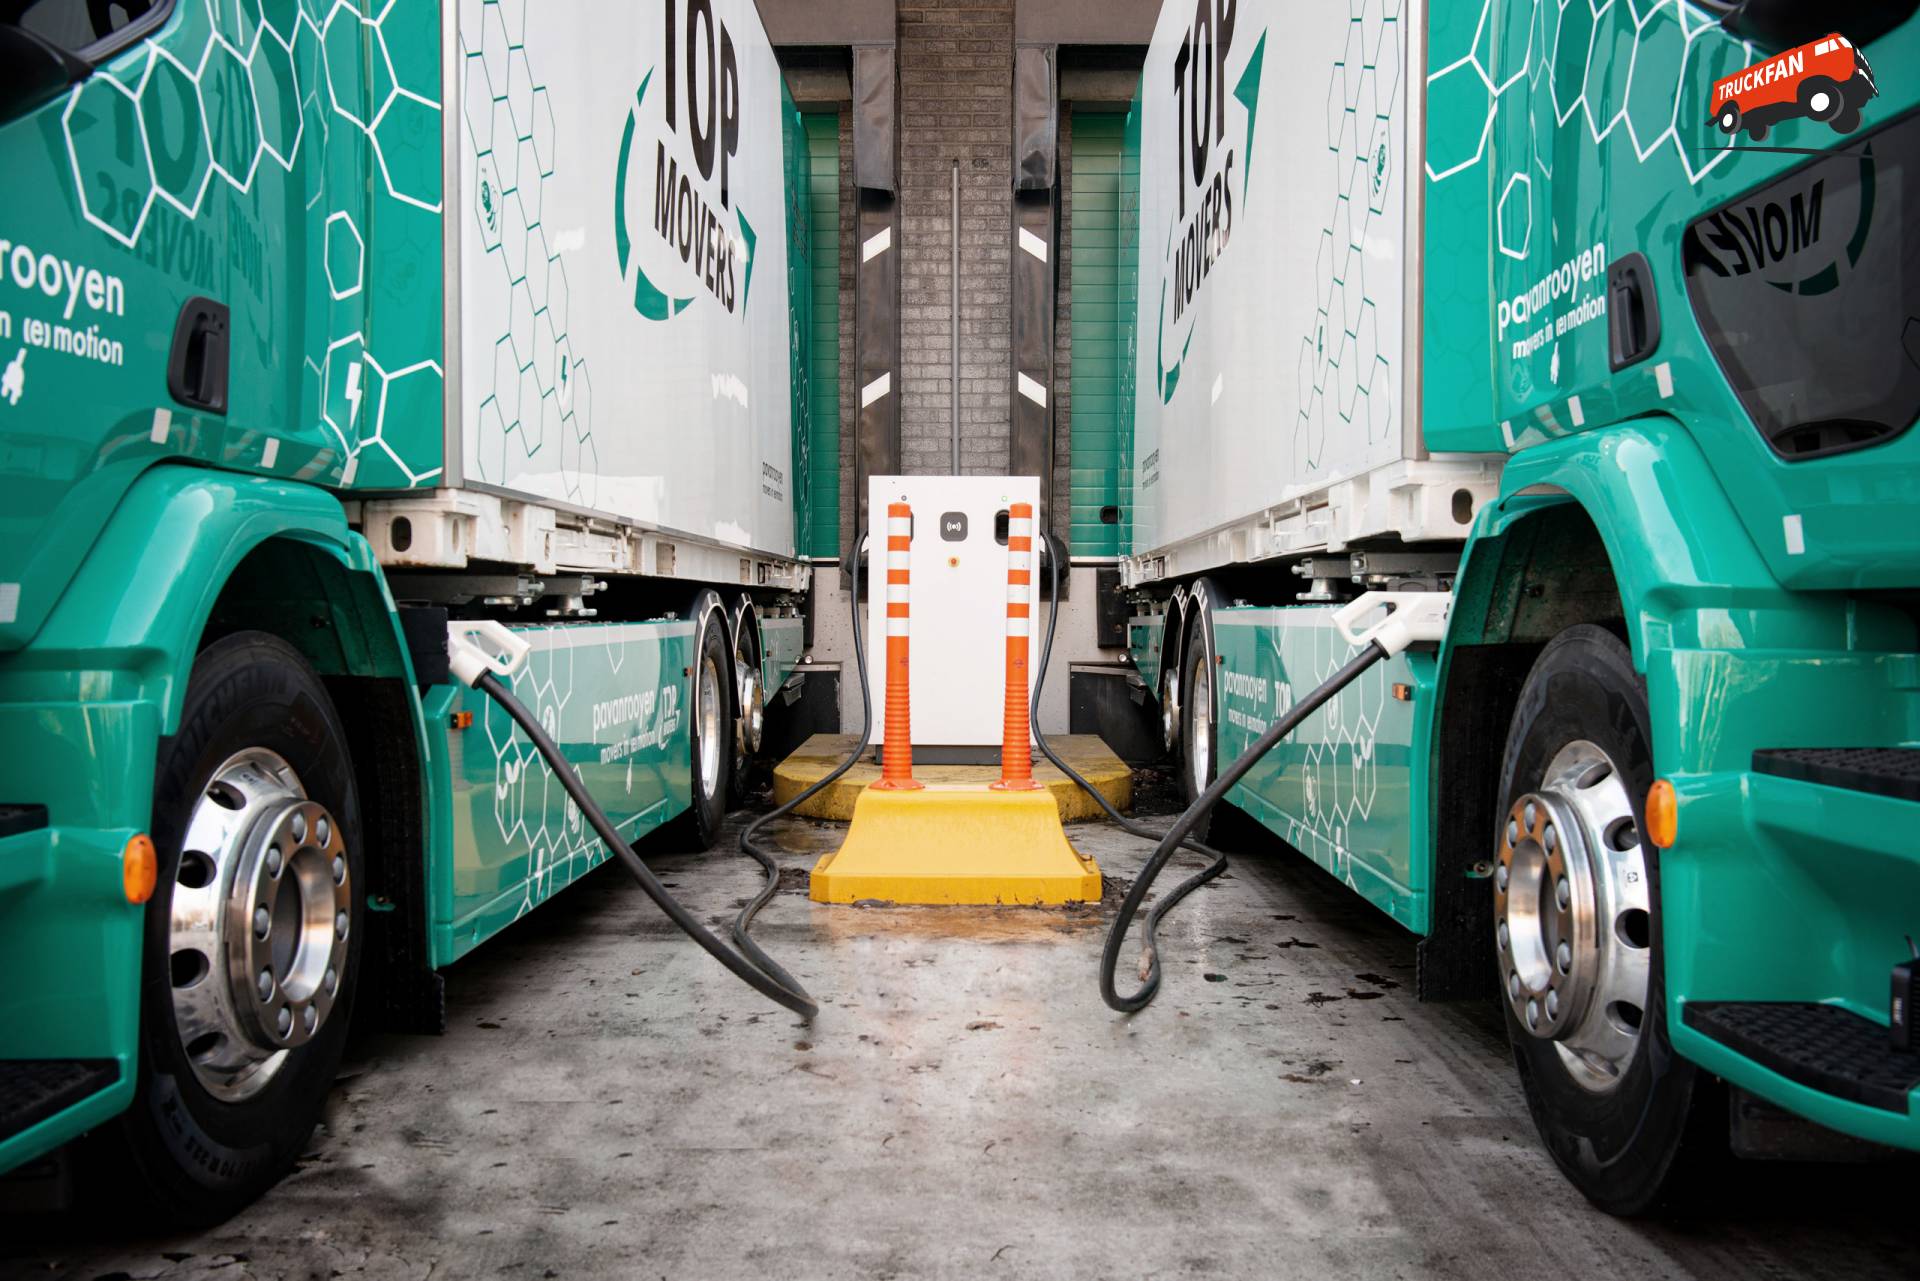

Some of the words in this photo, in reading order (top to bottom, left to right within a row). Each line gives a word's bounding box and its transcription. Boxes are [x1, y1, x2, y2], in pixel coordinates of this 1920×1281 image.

[654, 138, 736, 314] MOVERS
[1173, 149, 1233, 325] MOVERS
[1498, 242, 1606, 342] pavanrooyen
[1512, 328, 1545, 359] movers
[1545, 317, 1554, 342] in
[593, 689, 655, 745] pavanrooyen
[1224, 671, 1267, 712] pavanrooyen
[1275, 680, 1291, 718] TOP
[601, 742, 622, 765] movers
